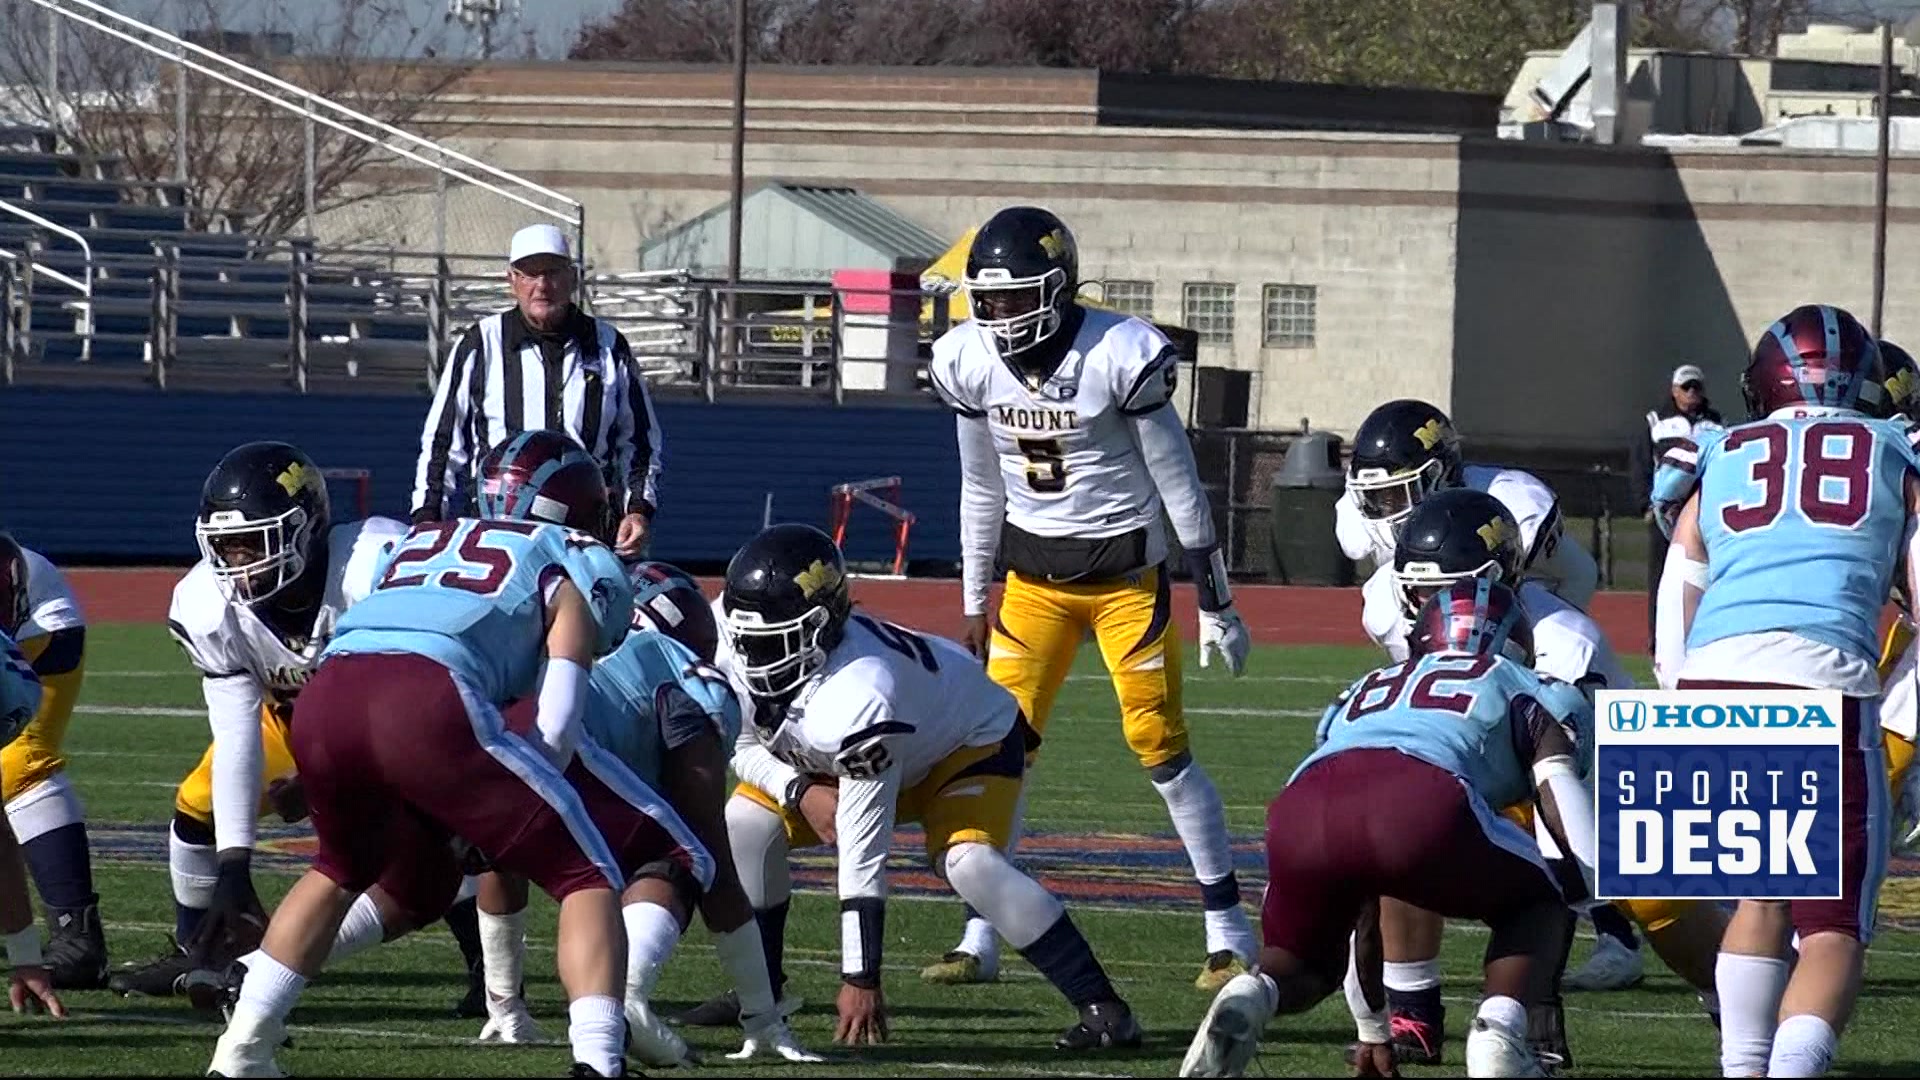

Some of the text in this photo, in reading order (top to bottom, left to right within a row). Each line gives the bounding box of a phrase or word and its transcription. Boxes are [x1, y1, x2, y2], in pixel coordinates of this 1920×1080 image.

[998, 407, 1079, 430] MOUNT
[1016, 436, 1068, 493] 5
[1722, 423, 1873, 533] 38
[376, 519, 541, 595] 25
[1346, 652, 1501, 724] 82
